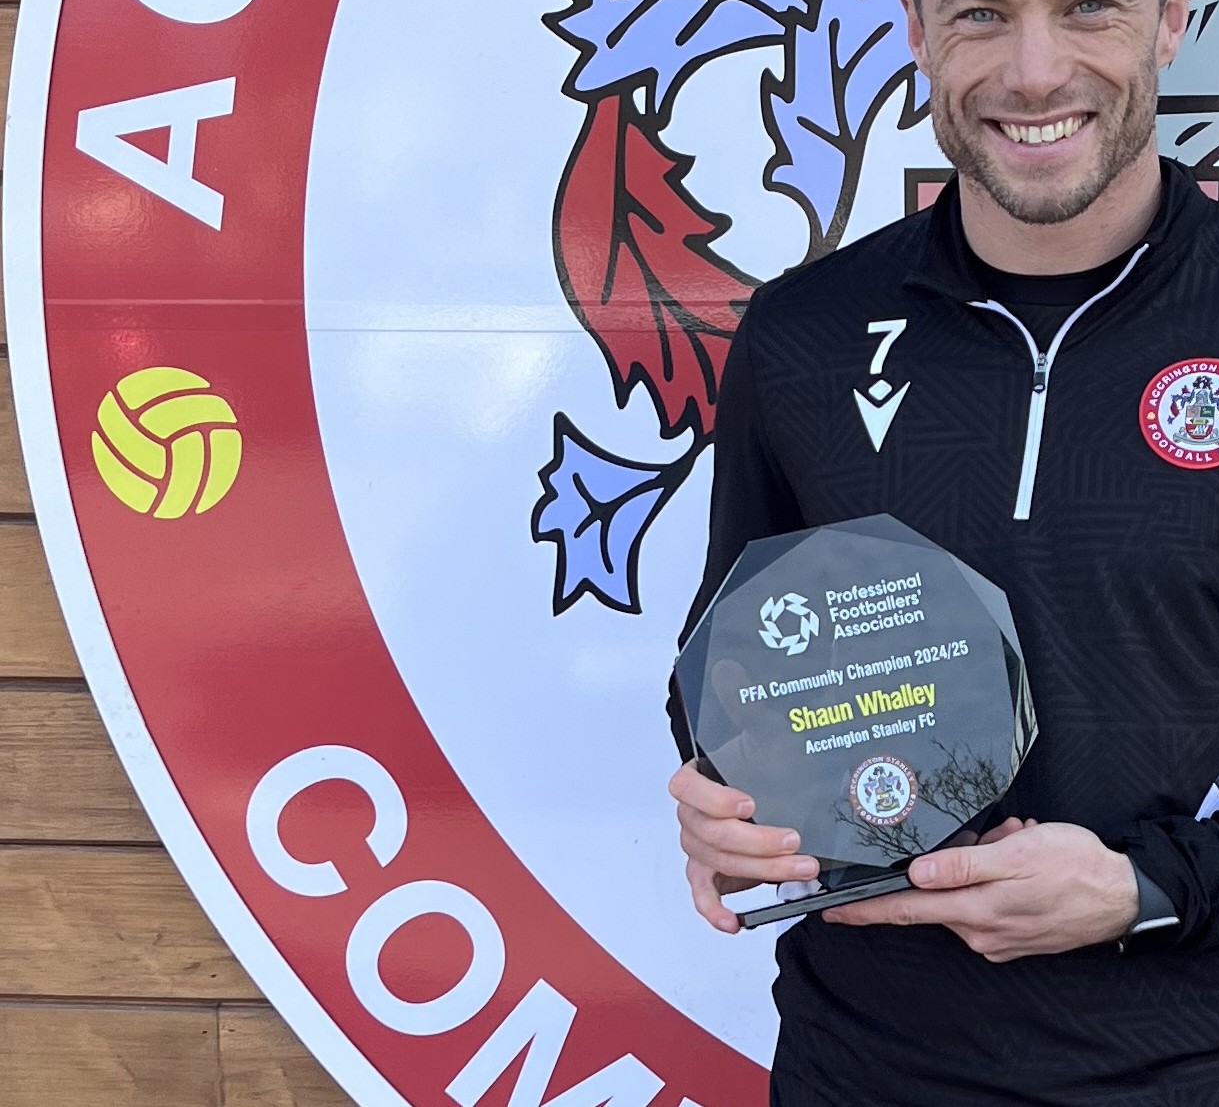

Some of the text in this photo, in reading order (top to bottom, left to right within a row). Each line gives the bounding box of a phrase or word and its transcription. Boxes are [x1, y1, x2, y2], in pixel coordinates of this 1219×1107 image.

[867, 318, 907, 375] 7
[1148, 362, 1218, 407] ACCRINGTON
[1148, 424, 1213, 463] FOOTBALL
[825, 571, 922, 606] Professional
[829, 588, 922, 623] Footballers'
[834, 609, 925, 640] Association
[739, 639, 969, 704] PFA Community Champion 2024/25
[788, 682, 936, 733] Shaun Whalley
[805, 711, 936, 755] Accrington Stanley FC
[246, 744, 705, 1107] COM
